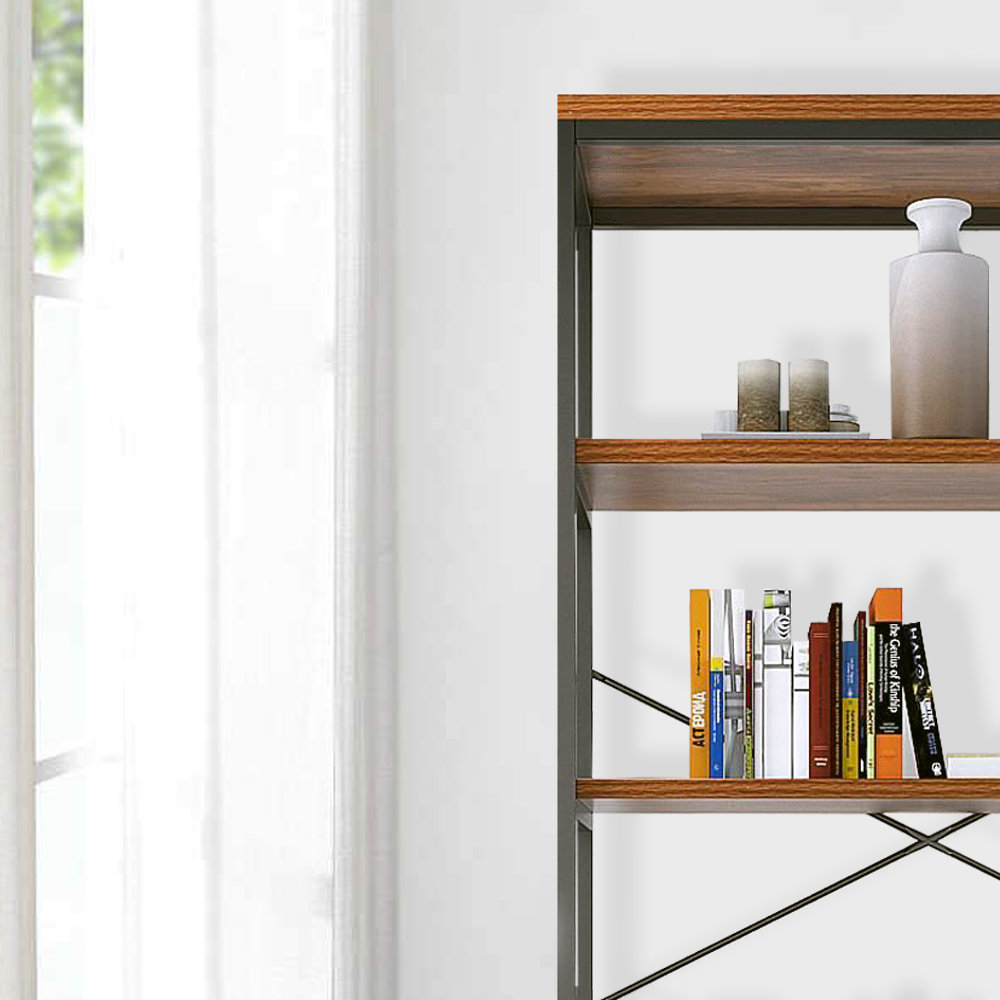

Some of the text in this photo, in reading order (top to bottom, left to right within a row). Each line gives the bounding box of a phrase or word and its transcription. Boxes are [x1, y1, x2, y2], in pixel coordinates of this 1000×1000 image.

[889, 623, 900, 637] the
[889, 639, 901, 668] Genius
[910, 627, 925, 680] HALO
[889, 669, 901, 680] of
[888, 681, 901, 713] Kinship
